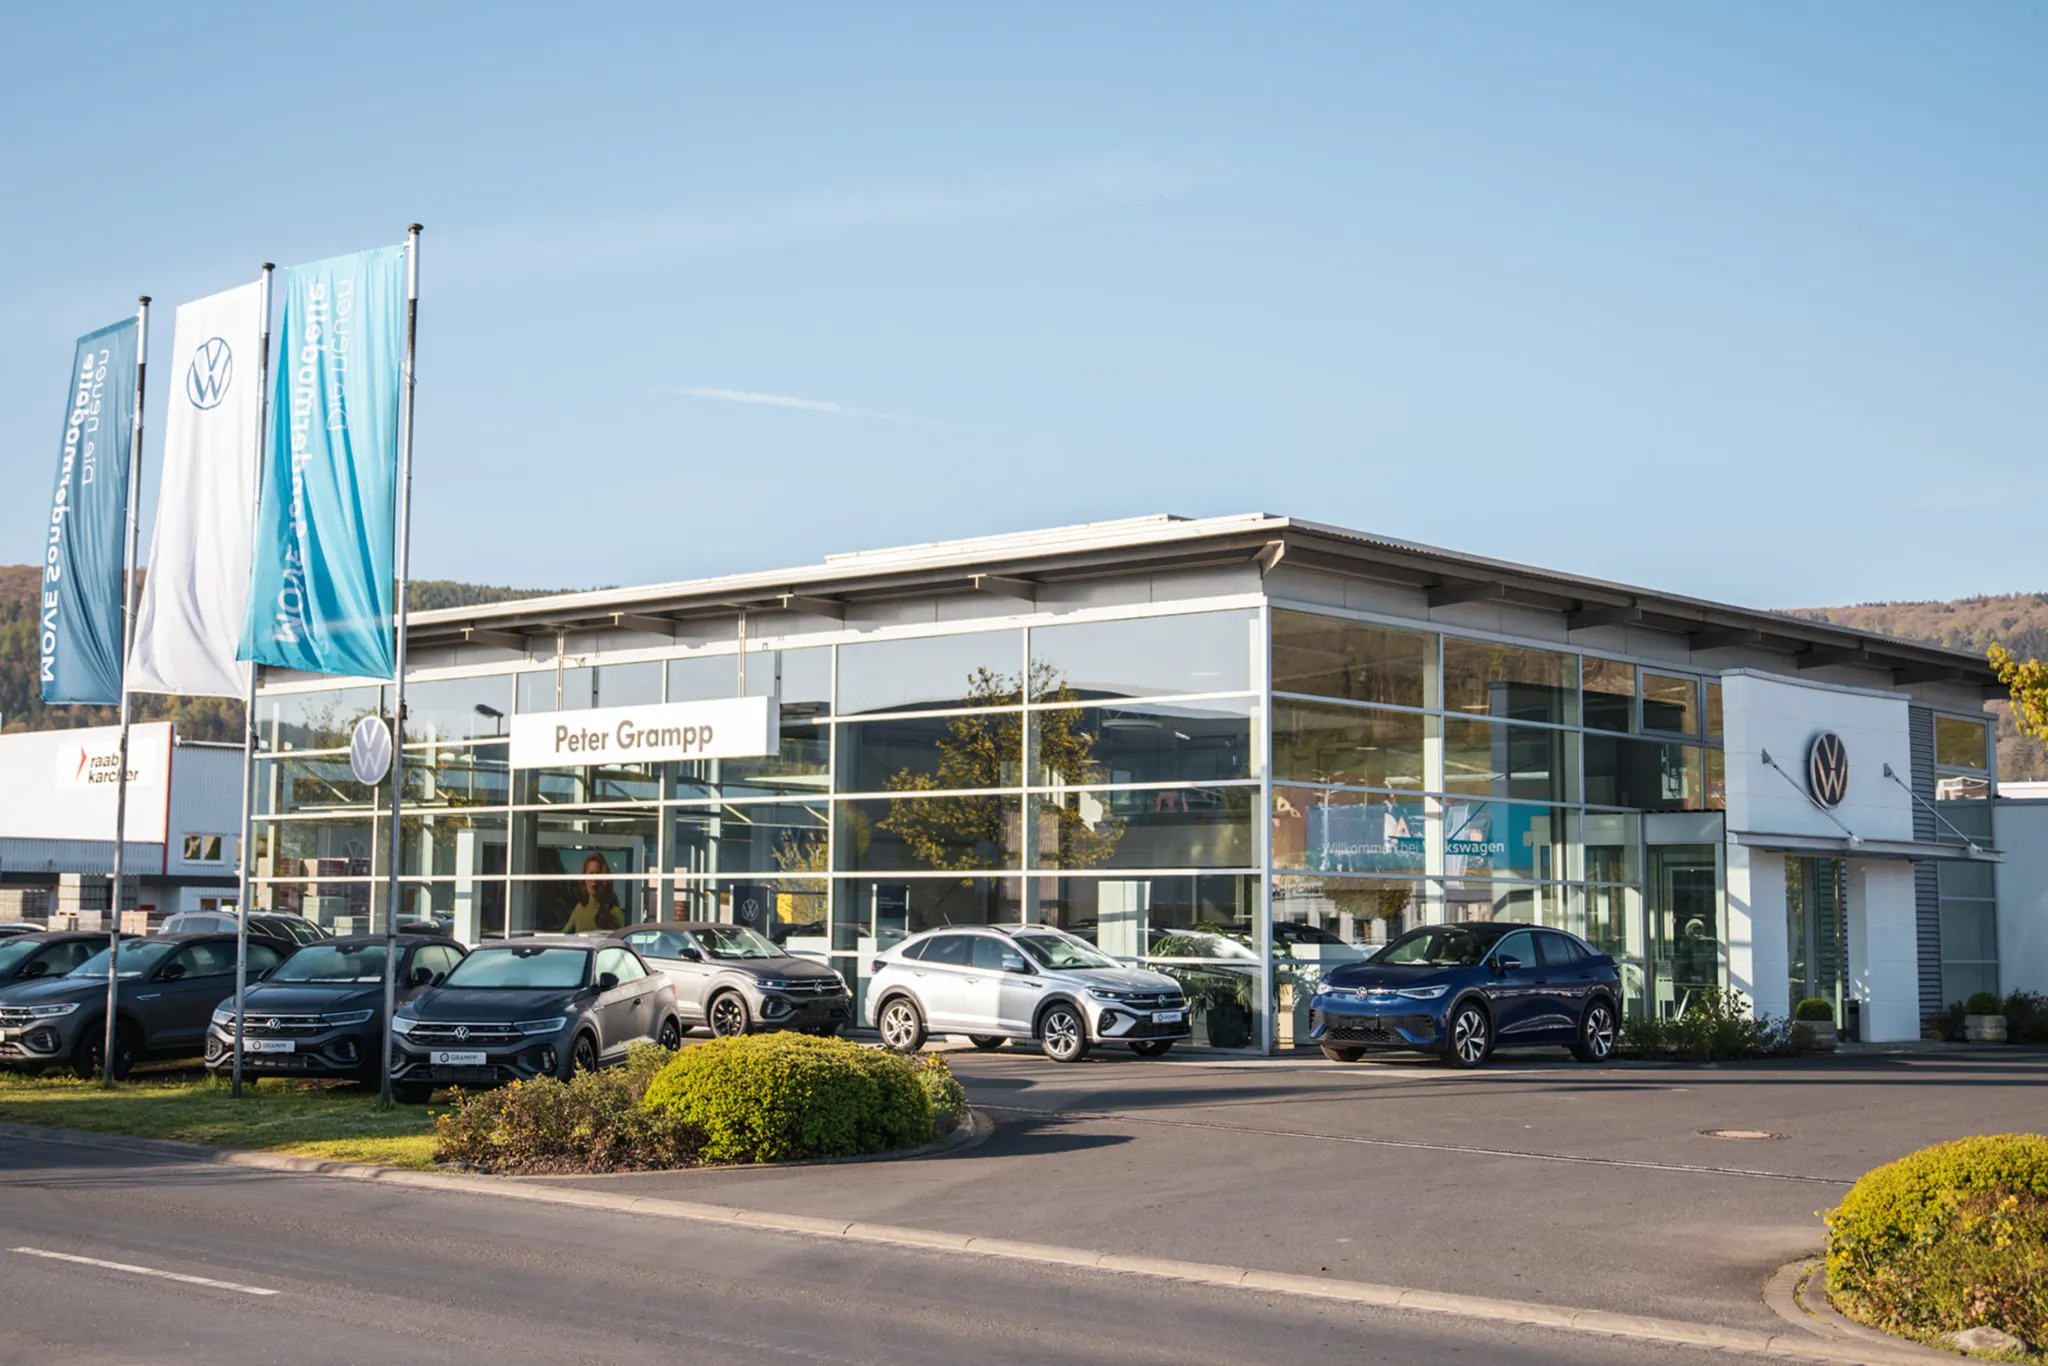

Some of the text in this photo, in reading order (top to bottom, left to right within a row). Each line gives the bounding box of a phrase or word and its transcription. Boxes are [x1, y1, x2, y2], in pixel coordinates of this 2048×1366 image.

[555, 719, 714, 753] Peter Grampp
[90, 752, 120, 768] raab
[1422, 841, 1505, 855] kswagen
